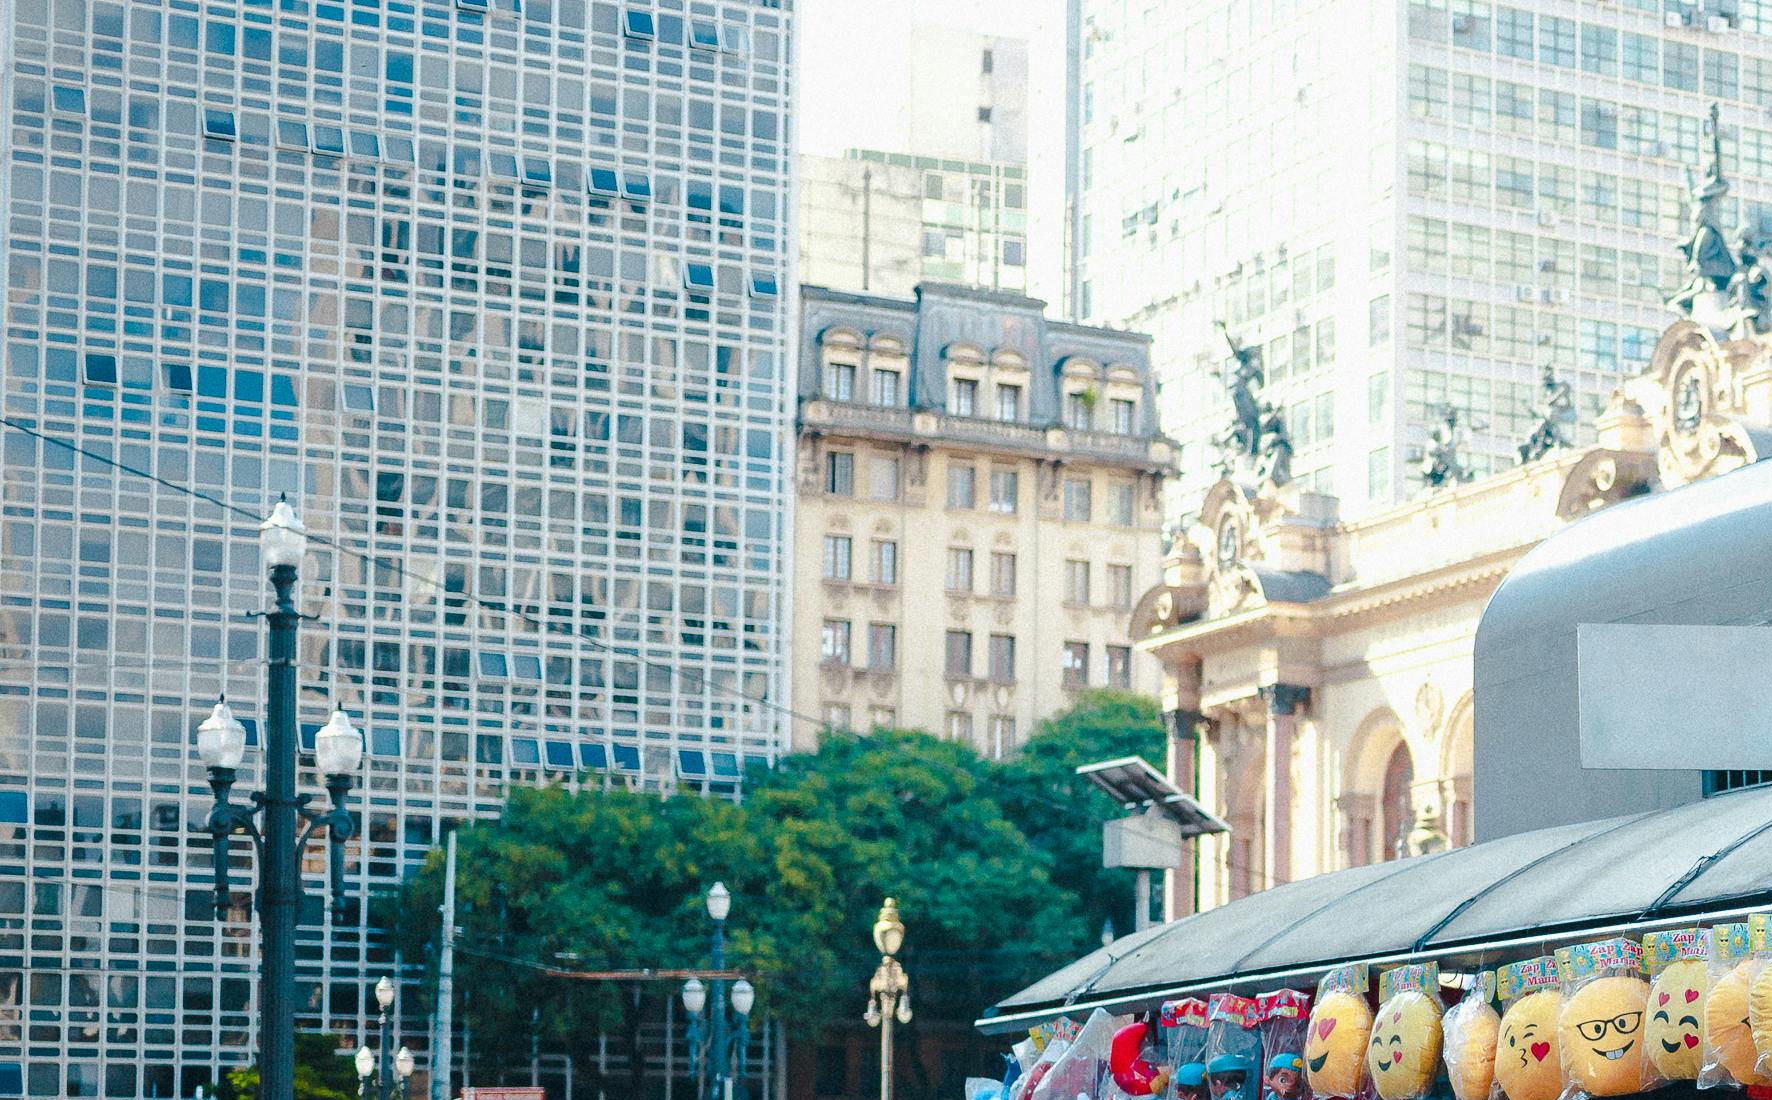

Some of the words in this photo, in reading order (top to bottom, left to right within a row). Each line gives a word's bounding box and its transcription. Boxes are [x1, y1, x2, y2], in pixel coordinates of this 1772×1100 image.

[1673, 933, 1695, 945] Zap
[1590, 944, 1615, 956] Zap
[1622, 941, 1643, 957] Zap
[1520, 961, 1540, 973] Zap
